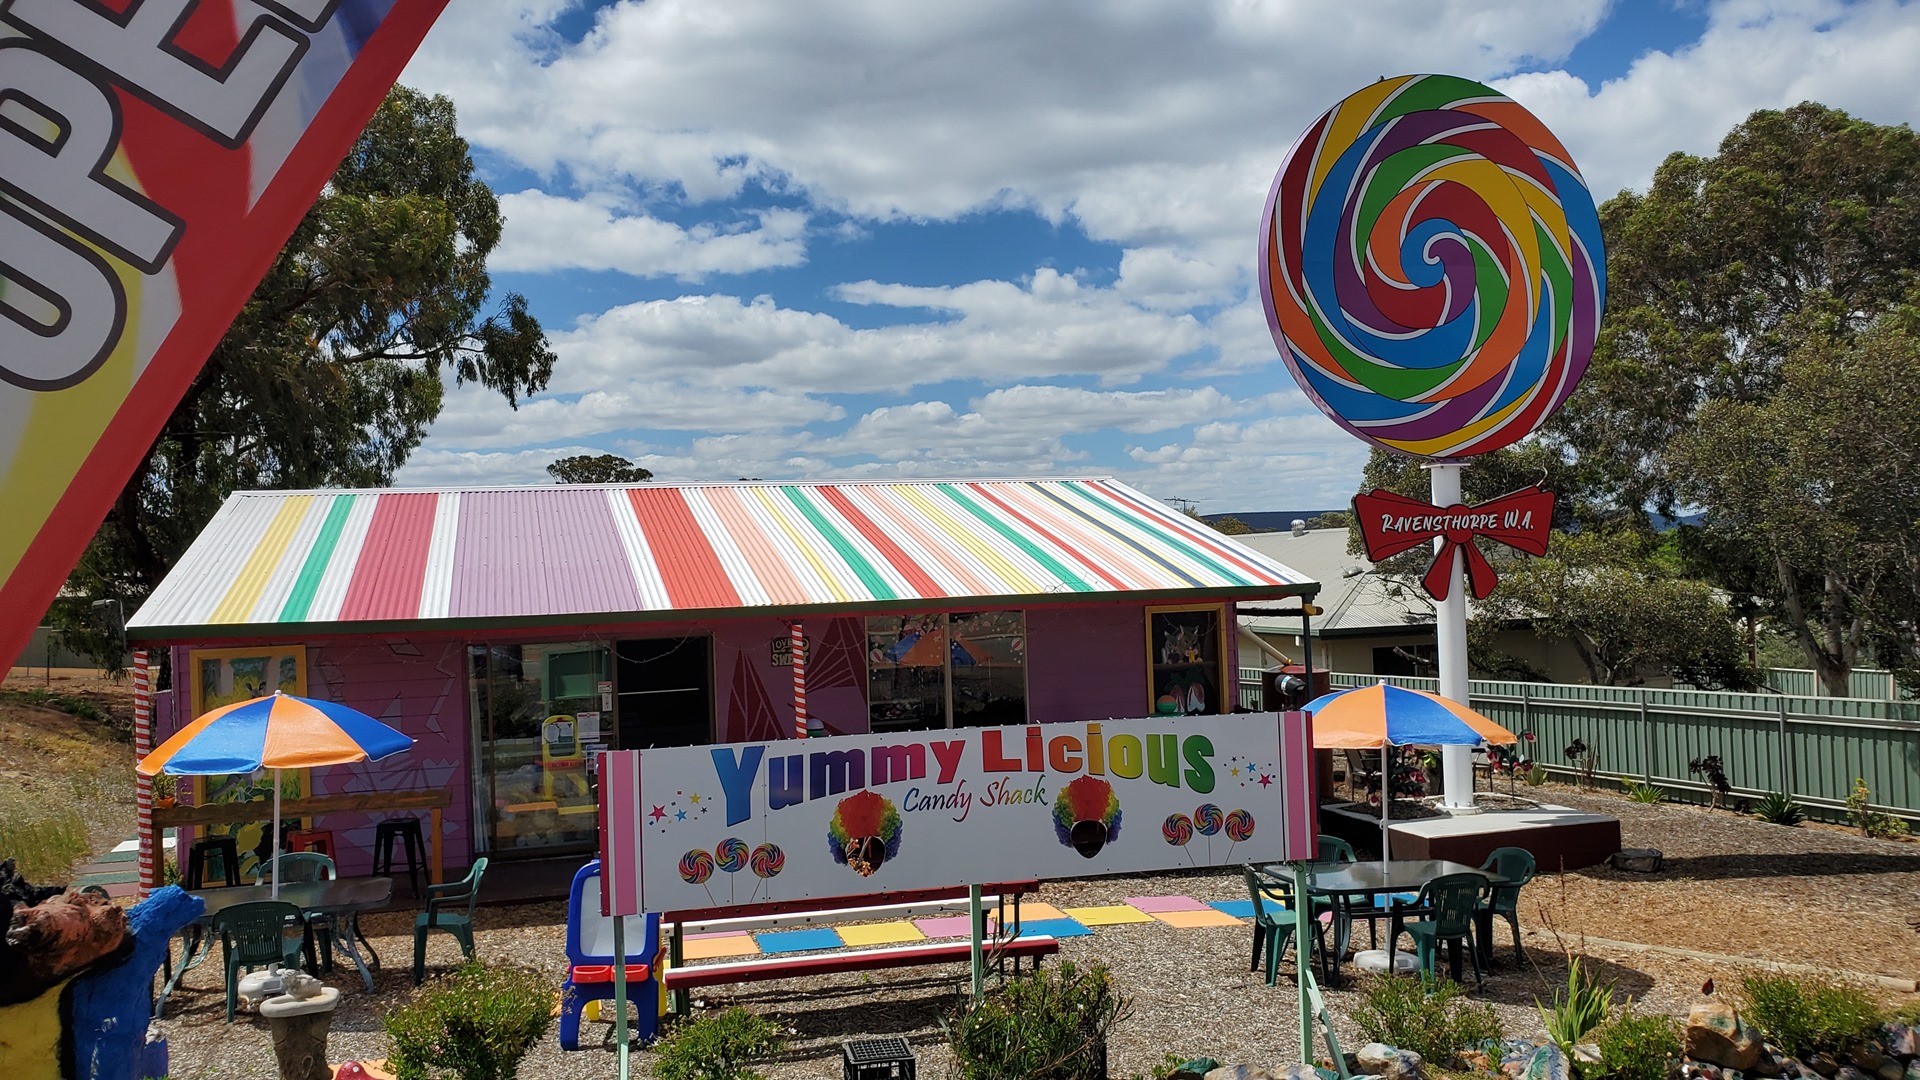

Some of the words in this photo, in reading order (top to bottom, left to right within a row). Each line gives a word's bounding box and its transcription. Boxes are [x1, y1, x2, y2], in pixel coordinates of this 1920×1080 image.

[1381, 513, 1499, 533] RAVENSTHORPE
[1504, 508, 1534, 531] W.A.
[771, 637, 793, 654] LOVE
[771, 651, 810, 667] SWET
[710, 739, 967, 828] Yummy
[981, 722, 1216, 795] Licious
[903, 779, 972, 823] Candy
[979, 773, 1049, 807] Shack
